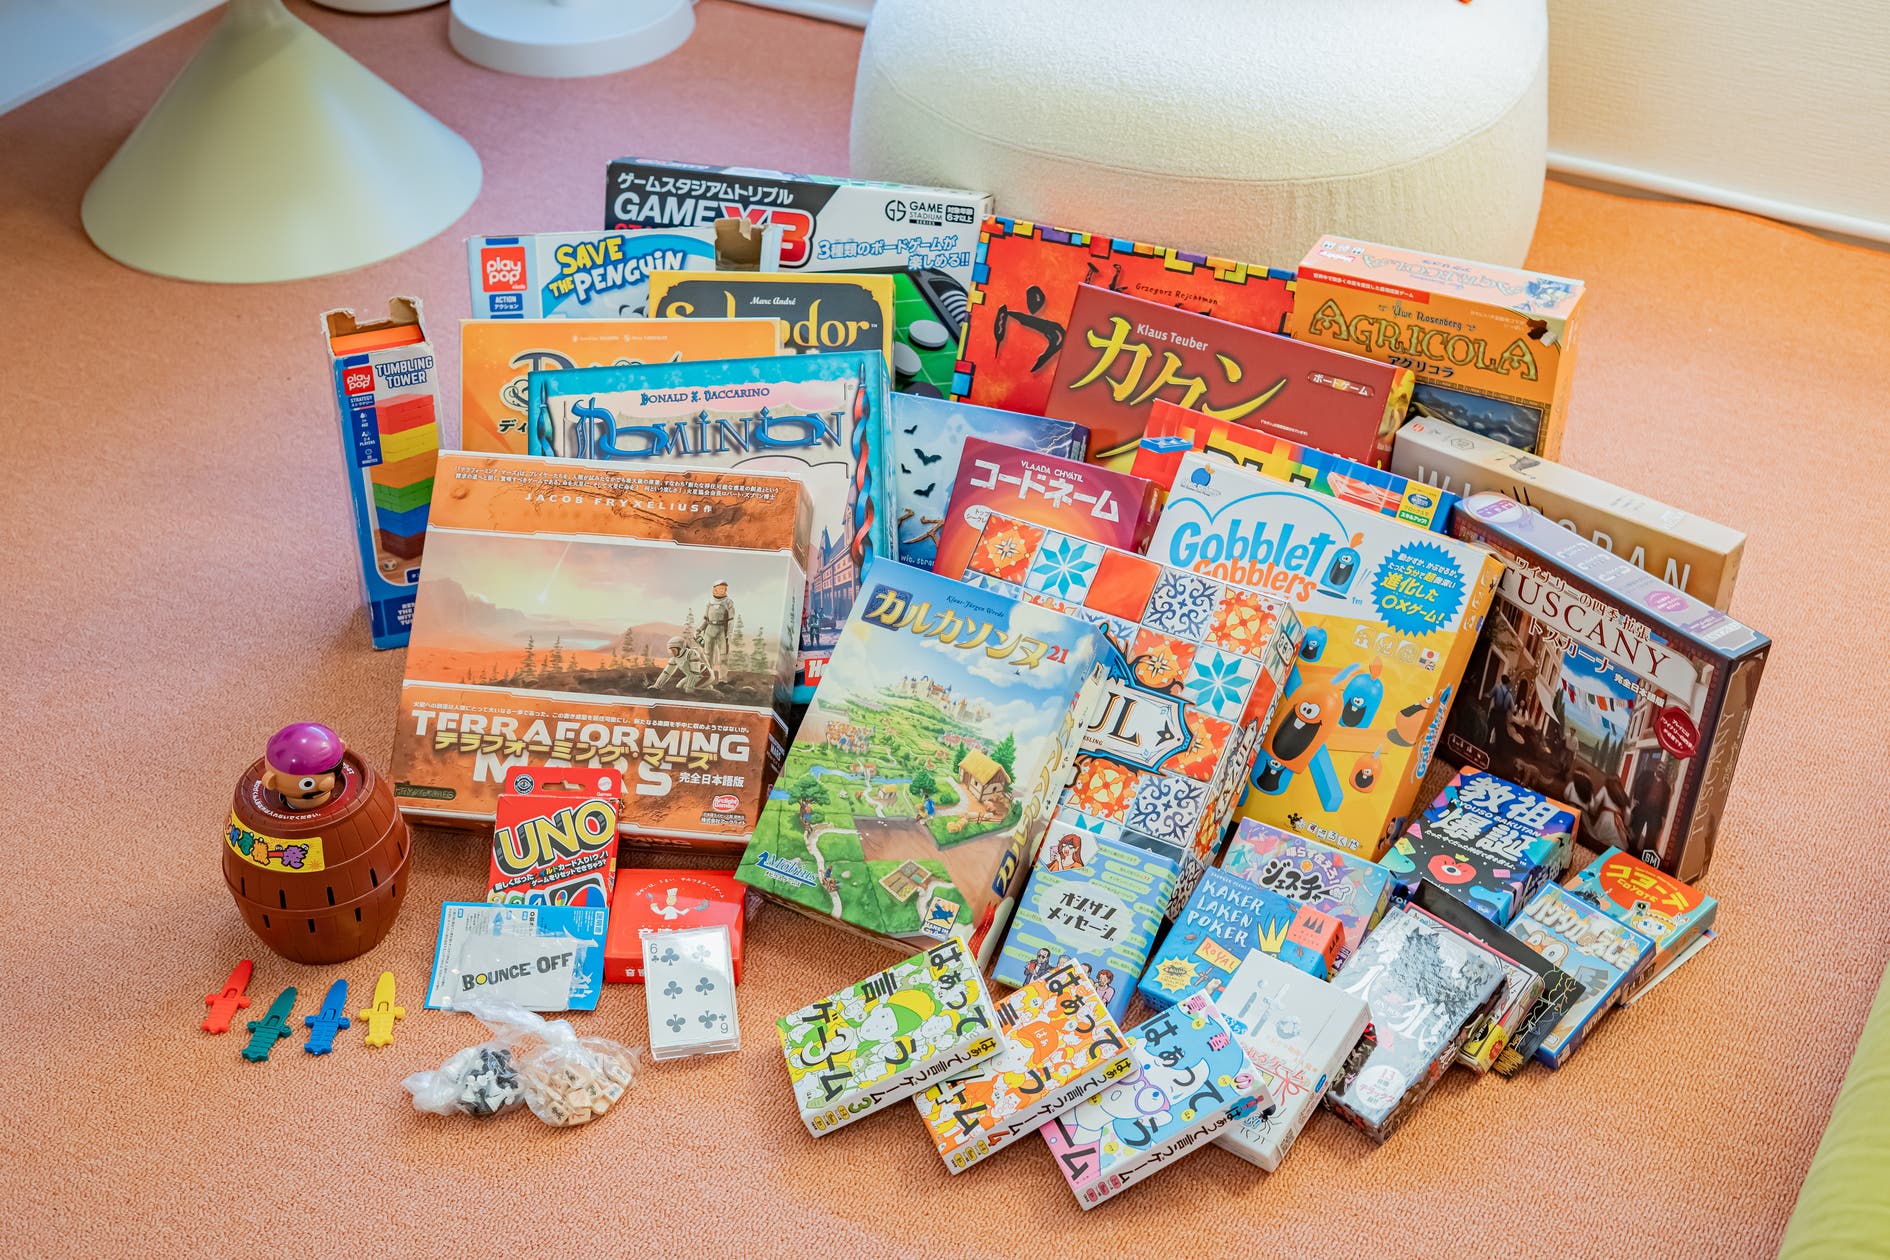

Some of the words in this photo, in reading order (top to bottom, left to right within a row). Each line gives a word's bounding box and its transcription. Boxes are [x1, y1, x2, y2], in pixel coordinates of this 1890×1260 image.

[617, 172, 793, 205] ゲームスタジアムトリプル
[613, 191, 719, 228] GAME
[909, 201, 943, 213] GAME
[909, 211, 943, 221] STADIUM
[555, 236, 624, 275] SAVE
[817, 235, 958, 260] 3種類のボードゲームが
[486, 257, 522, 275] play
[488, 270, 521, 285] pop
[495, 295, 517, 303] ACTION
[549, 277, 576, 298] THE
[750, 296, 770, 305] Marc
[772, 296, 796, 306] André
[1135, 283, 1172, 296] Grzegorz
[1416, 311, 1462, 331] Rosenberg
[1137, 323, 1168, 340] Klaus
[1170, 332, 1208, 351] Teuber
[1309, 299, 1538, 382] AGRICOLA
[347, 373, 371, 384] play
[376, 356, 433, 377] TUMBLING
[386, 371, 427, 389] TOWER
[1068, 316, 1287, 423] カタン
[1388, 355, 1454, 378] アグリコラ
[349, 381, 370, 391] pop
[640, 391, 688, 406] DONALD
[704, 386, 770, 402] VACCARINO
[1313, 373, 1368, 397] ボードゲーム
[1020, 460, 1051, 474] VLAADA
[1054, 468, 1084, 483] CHVÁTIL
[524, 493, 583, 504] JACOB
[594, 498, 699, 512] FRYXELIUS
[970, 458, 1119, 523] コードネーム
[1169, 519, 1336, 577] Gobblet
[1193, 558, 1317, 602] Gobblers
[1380, 572, 1439, 603] 進化した
[1516, 556, 1620, 623] ワイナリーの四季
[1622, 614, 1652, 642] 拡張
[865, 590, 1049, 670] カルカソンヌ
[1499, 566, 1671, 678] TUSCANY
[1047, 645, 1069, 664] 21
[1528, 616, 1614, 673] トスカーナ
[1614, 673, 1665, 708] 完全日本語版
[411, 710, 751, 763] TERRAFORMING
[434, 731, 718, 771] テラフォーミング・マーズ
[679, 771, 745, 788] 完全日本語版
[1450, 798, 1492, 818] KYOUSO
[1494, 816, 1542, 838] BAKUTAN
[494, 799, 616, 875] UNO
[1202, 880, 1265, 916] KAKER
[1606, 864, 1689, 911] コヨーテ
[1617, 879, 1658, 903] COYOTE
[1062, 893, 1118, 920] オジサン
[1197, 895, 1253, 928] LAKEN
[1047, 907, 1118, 942] メッセージ
[1187, 910, 1249, 948] POKER
[650, 943, 658, 954] 6
[1202, 942, 1238, 970] ROYAL
[537, 952, 573, 975] OFF
